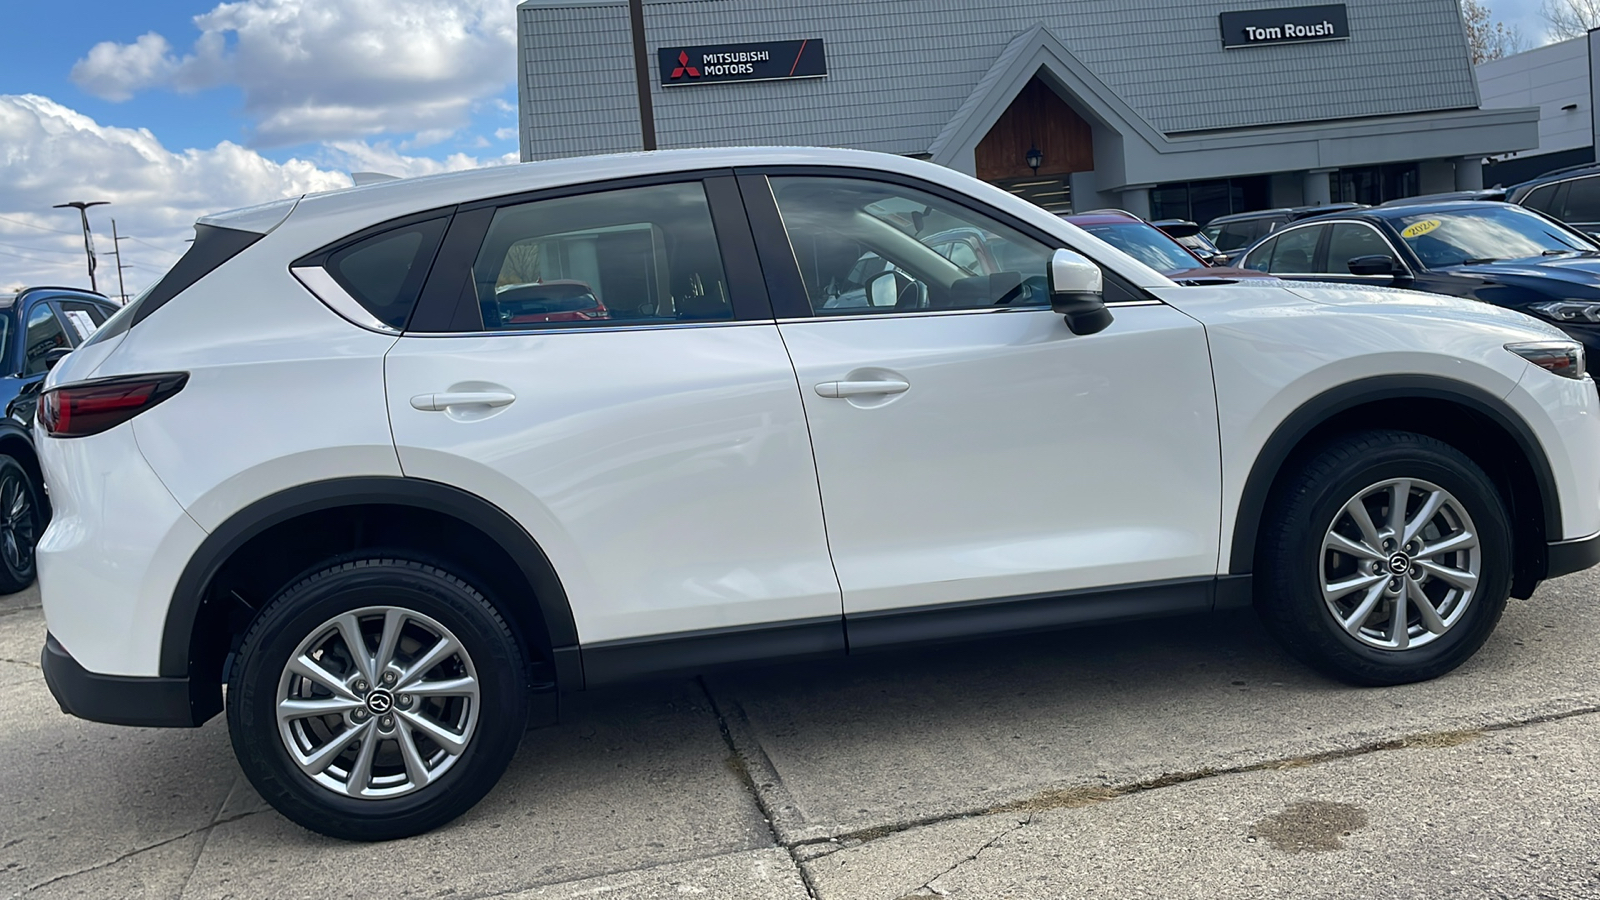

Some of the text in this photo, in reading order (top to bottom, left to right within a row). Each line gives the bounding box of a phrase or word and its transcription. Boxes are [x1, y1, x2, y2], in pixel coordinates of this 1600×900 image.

[1245, 20, 1334, 40] Tom Roush
[702, 51, 769, 64] MITSUBISHI
[704, 63, 753, 76] MOTORS
